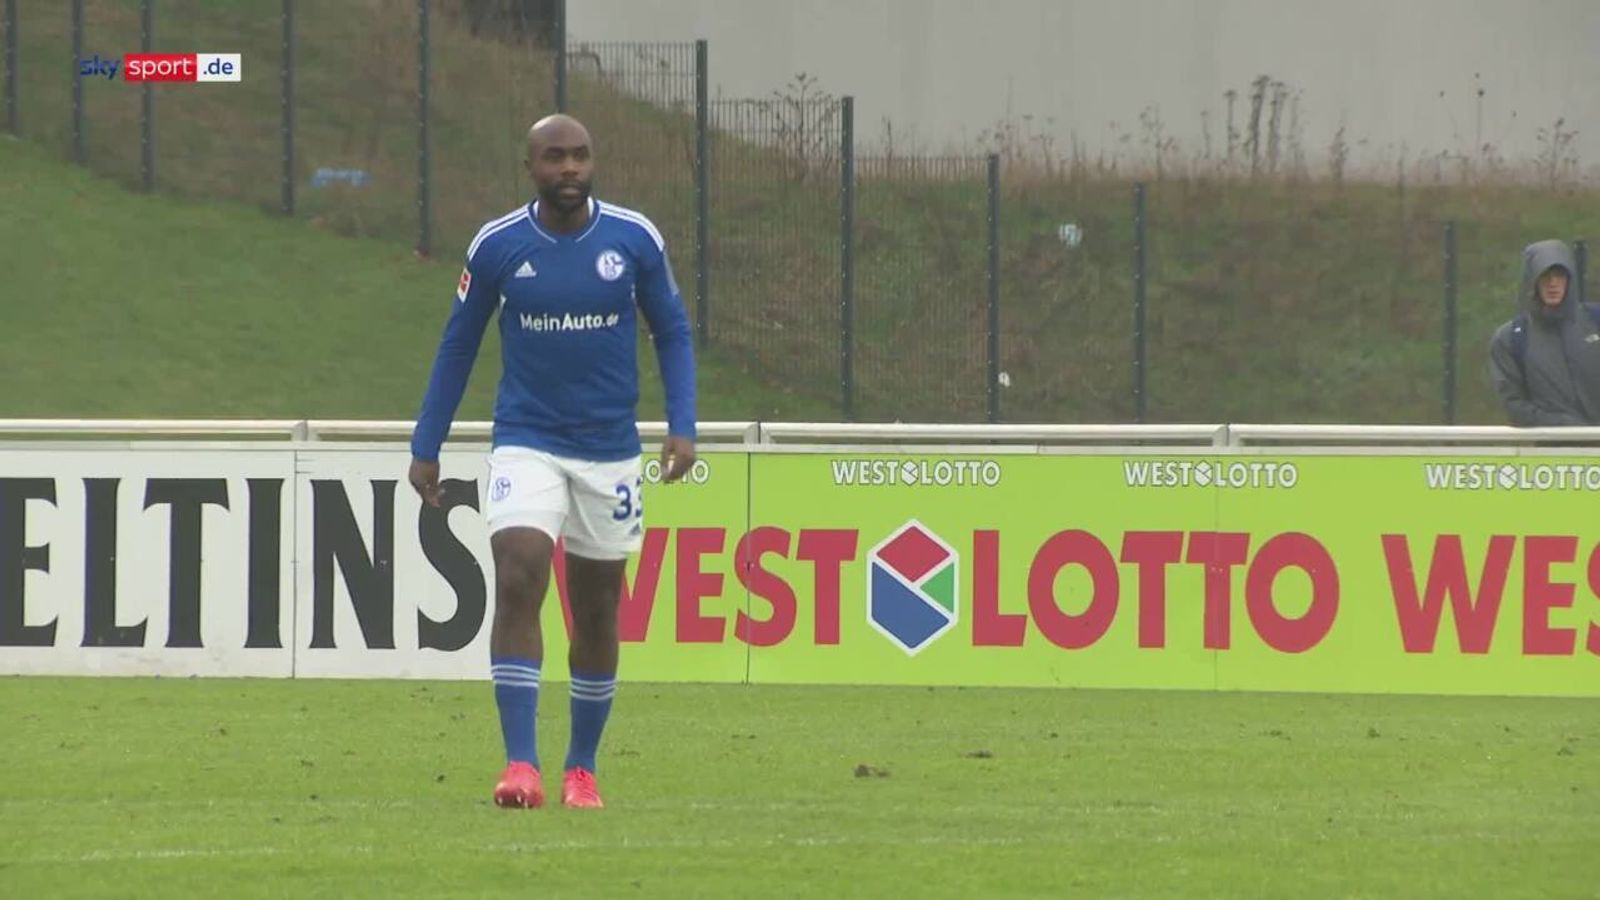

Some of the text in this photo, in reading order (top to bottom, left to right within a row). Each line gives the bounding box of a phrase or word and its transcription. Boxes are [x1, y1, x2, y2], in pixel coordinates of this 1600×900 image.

[832, 460, 1001, 486] WEST LOTTO
[1124, 461, 1298, 488] WEST LOTTO
[1426, 463, 1600, 491] WEST LOTTO
[0, 477, 487, 652] ELTINS
[973, 529, 1340, 653] LOTTO
[1381, 534, 1600, 656] WE
